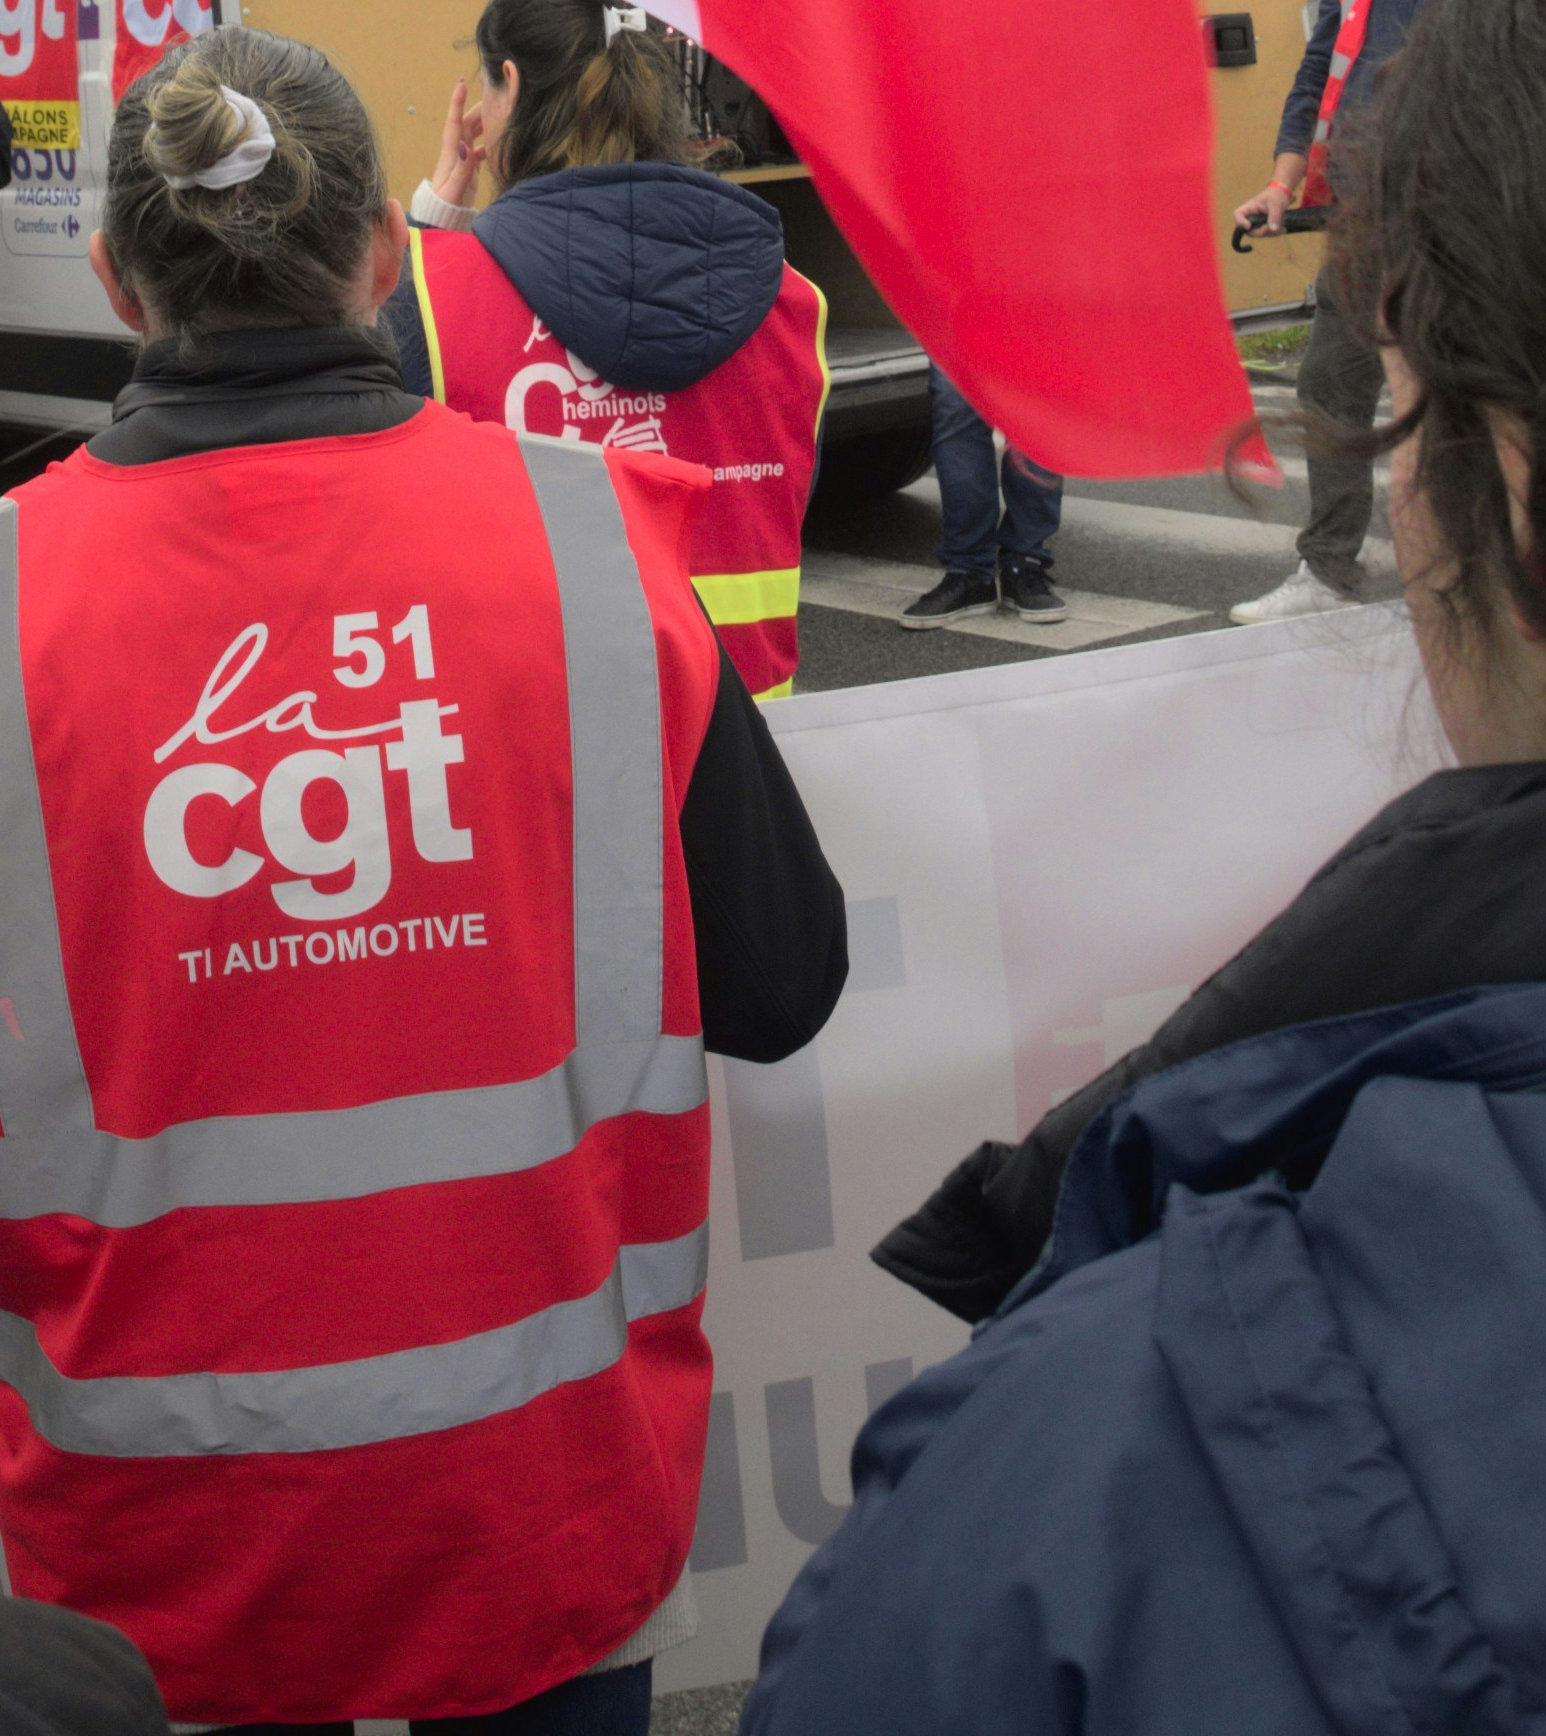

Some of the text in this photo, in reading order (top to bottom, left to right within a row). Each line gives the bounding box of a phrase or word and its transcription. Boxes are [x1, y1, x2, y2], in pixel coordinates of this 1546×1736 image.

[14, 217, 59, 234] Carrefour
[15, 188, 81, 207] MAGASINS
[332, 604, 436, 688] 51
[154, 623, 459, 764] la
[143, 698, 474, 921] cgt
[178, 913, 488, 983] TI AUTOMOTIVE
